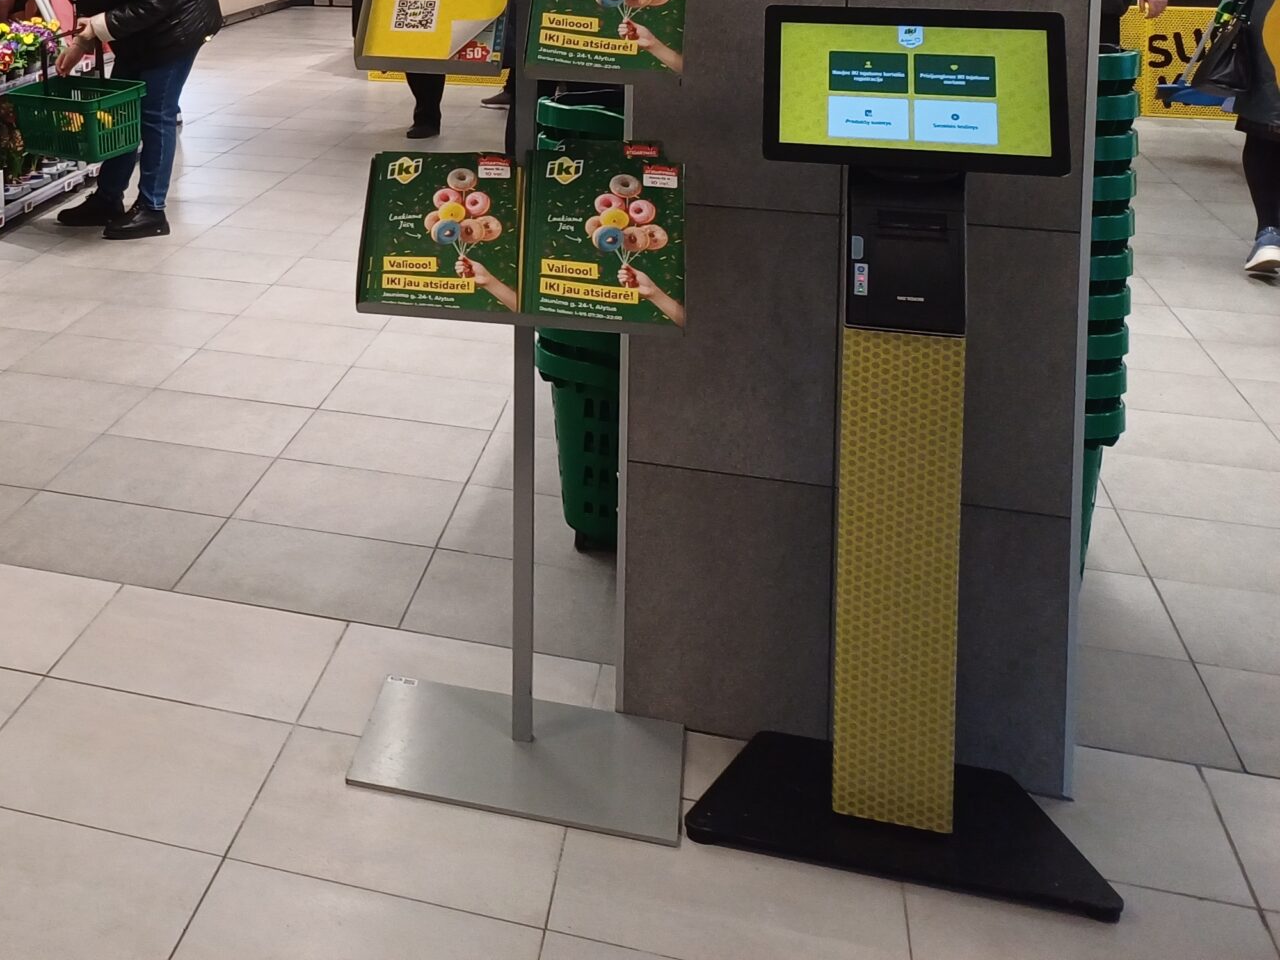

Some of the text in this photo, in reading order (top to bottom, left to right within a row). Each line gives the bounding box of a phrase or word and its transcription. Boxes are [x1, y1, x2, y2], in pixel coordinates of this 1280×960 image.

[548, 17, 593, 30] Valiooo!
[545, 33, 633, 52] IKI jau atsidarė!
[389, 159, 420, 177] iki
[548, 160, 581, 176] iki
[389, 260, 431, 269] Valiooo!
[547, 263, 592, 276] Valiooo!
[387, 277, 469, 290] IKI jau atsidarė!
[545, 281, 634, 300] IKI jau atsidarė!
